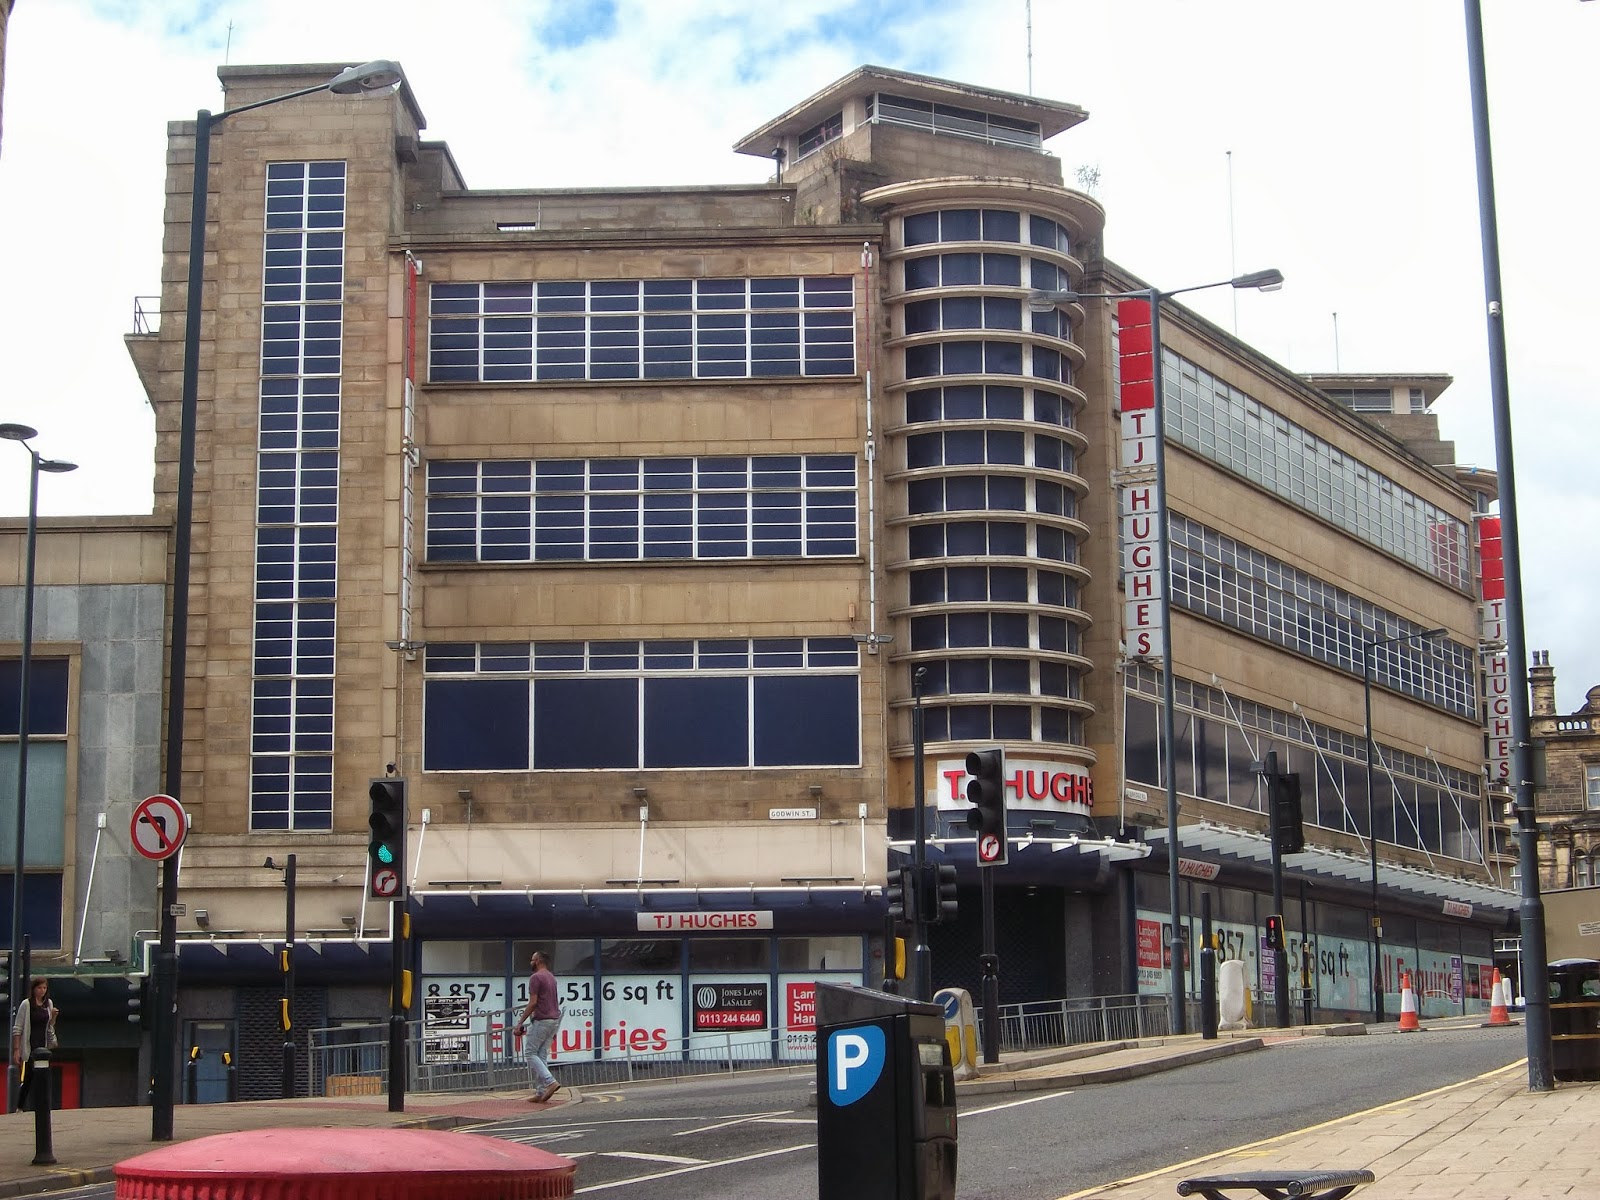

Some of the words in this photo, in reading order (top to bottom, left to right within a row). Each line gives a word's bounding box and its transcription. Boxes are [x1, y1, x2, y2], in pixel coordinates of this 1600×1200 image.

[1131, 413, 1147, 463] TJ
[1131, 490, 1151, 655] HUGHES
[1490, 602, 1503, 639] TJ
[1492, 657, 1510, 778] HUGHES
[1005, 770, 1094, 807] HUGHE
[771, 810, 800, 818] GODWIN
[653, 915, 673, 929] TJ
[679, 913, 757, 929] HUGHES
[1321, 950, 1335, 984] sq
[1339, 942, 1349, 977] ft
[623, 984, 648, 1005] sq
[656, 980, 674, 1000] ft
[743, 988, 763, 997] LANG
[569, 1008, 594, 1017] uses
[699, 1014, 720, 1024] 0113
[722, 1013, 738, 1023] 244
[739, 1013, 760, 1023] 6440
[836, 1034, 869, 1090] P
